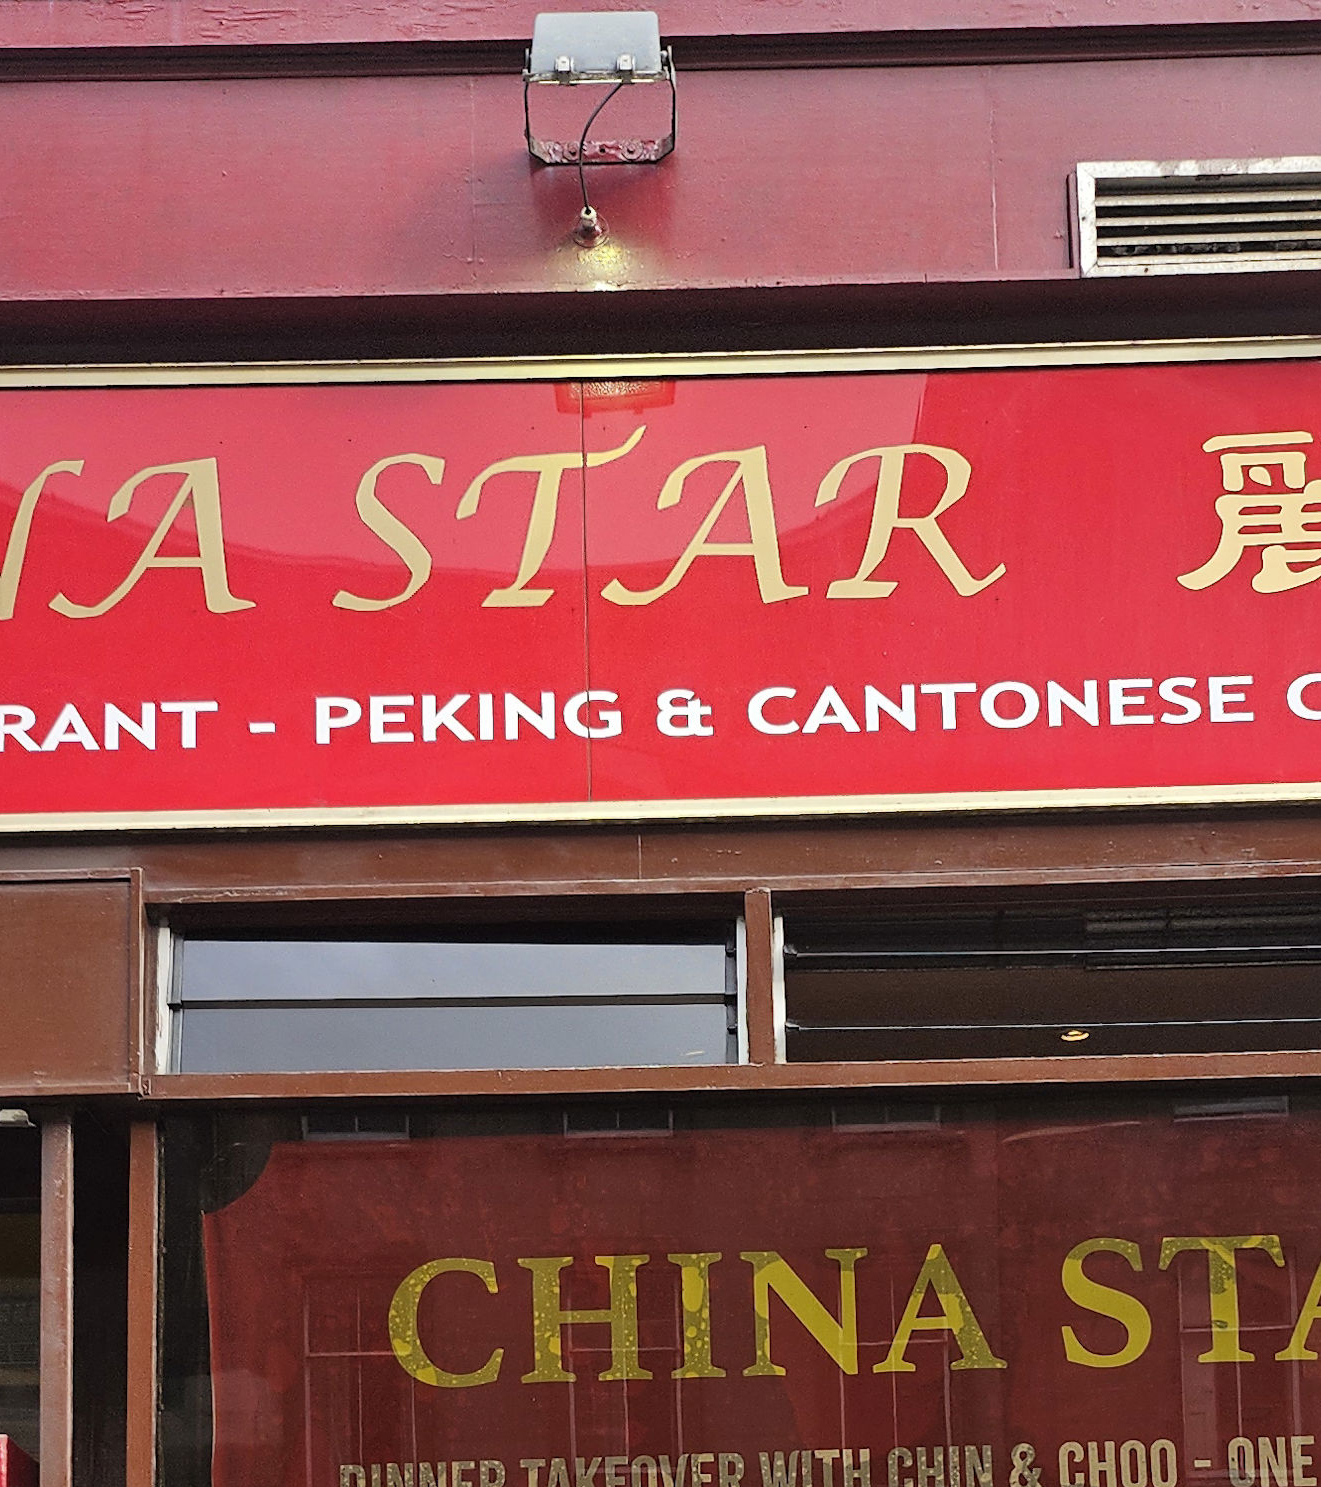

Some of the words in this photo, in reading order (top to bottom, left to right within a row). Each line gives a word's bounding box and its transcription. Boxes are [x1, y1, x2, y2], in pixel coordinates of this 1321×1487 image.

[331, 425, 1008, 612] STAR
[315, 690, 623, 745] PEKING
[655, 689, 714, 738] &
[748, 675, 1255, 735] CANTONESE
[388, 1243, 1008, 1388] CHINA
